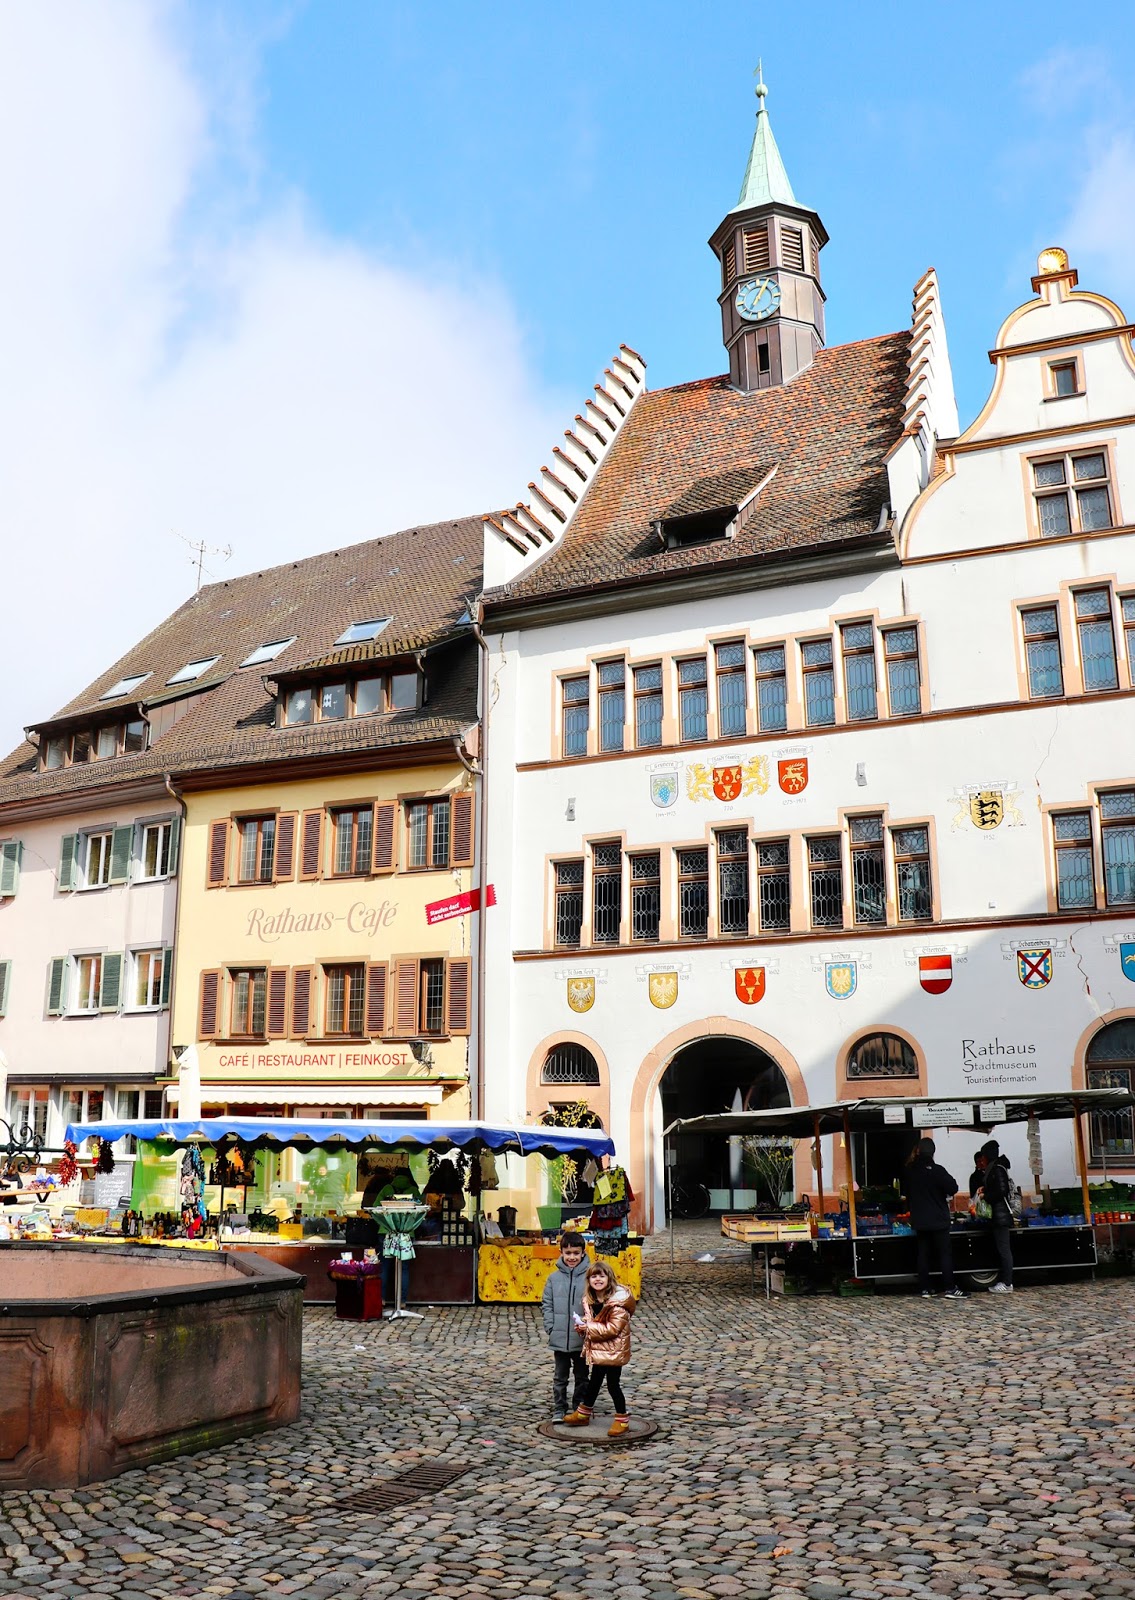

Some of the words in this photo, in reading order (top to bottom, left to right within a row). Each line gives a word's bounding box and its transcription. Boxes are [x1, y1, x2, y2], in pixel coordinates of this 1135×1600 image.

[449, 902, 460, 911] darf
[245, 900, 399, 943] Rathaus-Café
[962, 1037, 1036, 1059] Rathaus
[219, 1052, 249, 1067] CAFÉ
[257, 1054, 336, 1067] RESTAURANT
[345, 1053, 408, 1067] FEINKOST
[962, 1059, 1037, 1073] Stadtmuseum
[964, 1074, 1037, 1085] Touristinformation
